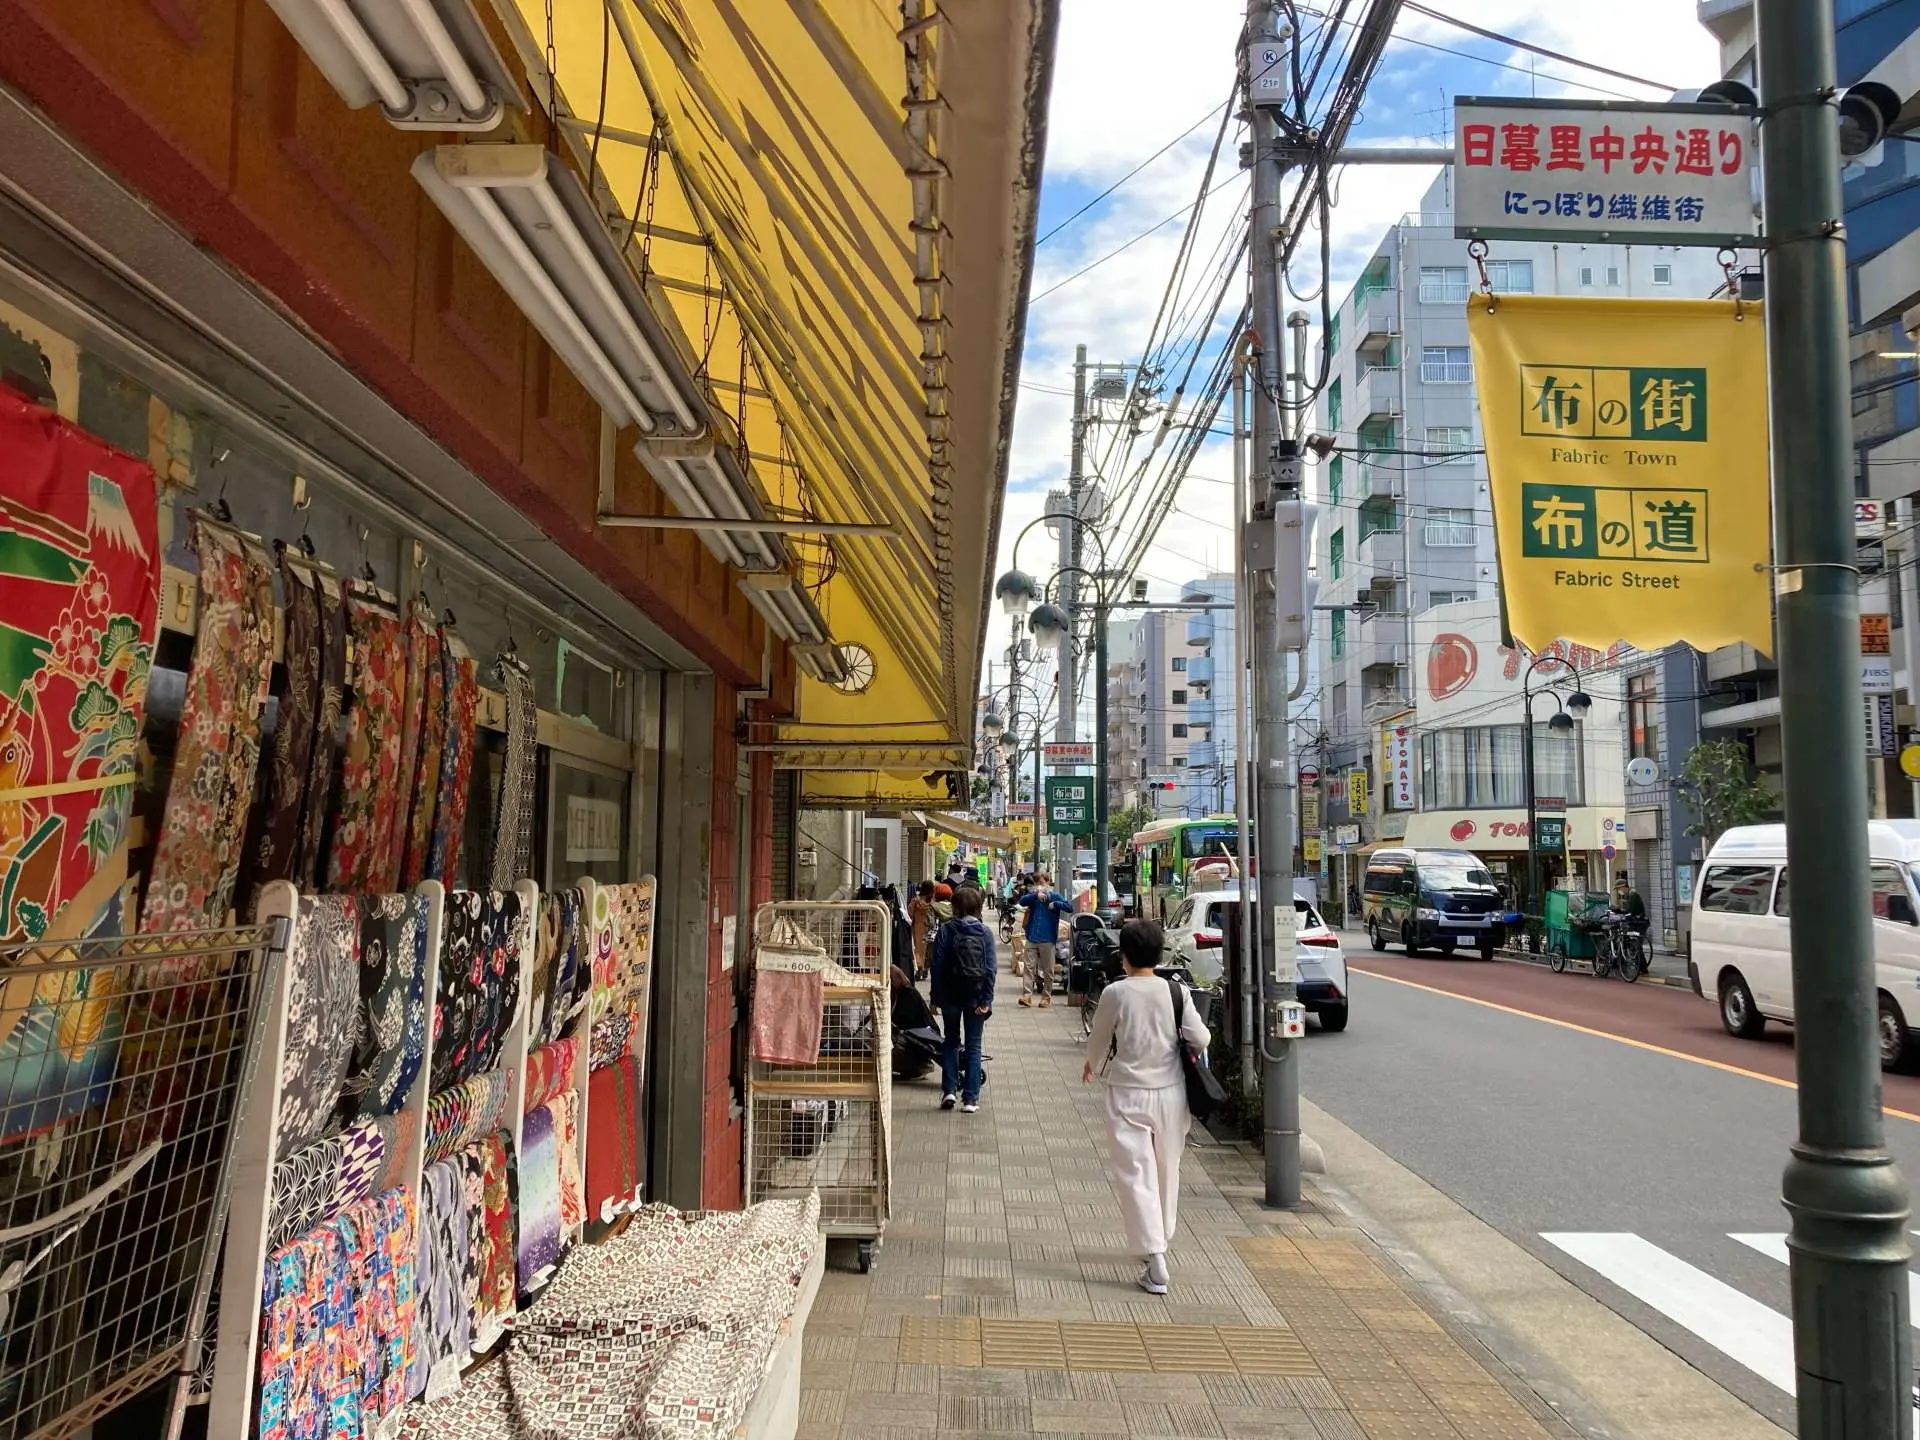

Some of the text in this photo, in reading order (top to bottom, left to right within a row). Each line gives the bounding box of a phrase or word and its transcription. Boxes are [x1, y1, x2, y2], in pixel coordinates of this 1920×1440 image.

[1463, 122, 1743, 177] 日暮里中央通り
[1504, 190, 1705, 222] にっぽり繊維街
[1531, 375, 1697, 432] 布の街
[1551, 447, 1677, 467] Fabric Town
[1532, 494, 1699, 553] 布の道
[1554, 569, 1681, 589] Fabric Street
[1398, 738, 1410, 801] TOMATO
